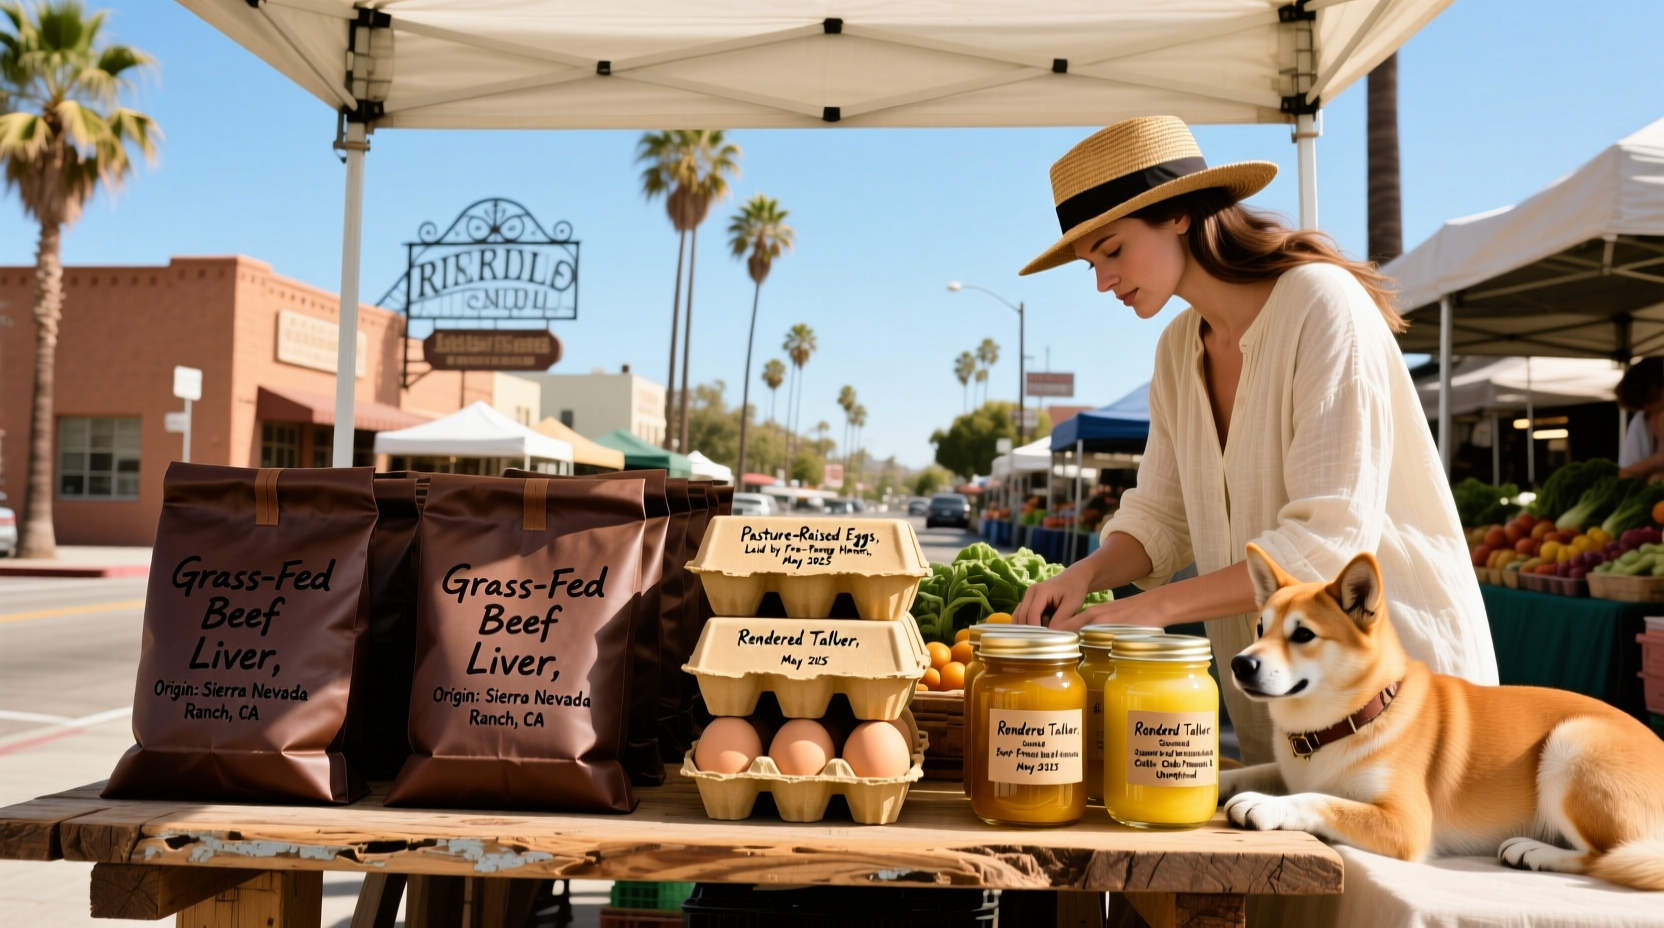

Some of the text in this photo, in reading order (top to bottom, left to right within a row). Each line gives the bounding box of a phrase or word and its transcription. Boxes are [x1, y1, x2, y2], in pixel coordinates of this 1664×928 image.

[846, 527, 879, 548] Eggs,
[770, 543, 780, 557] by
[171, 555, 336, 597] Grass-Fed
[442, 563, 608, 603] Grass-Fed
[201, 596, 286, 636] Beef
[478, 603, 563, 643] Beef
[737, 628, 804, 647] Rendered
[189, 636, 280, 677] Liver,
[466, 641, 559, 682] Liver,
[780, 654, 803, 670] May
[154, 680, 308, 701] Origin: Sierra Nevada
[433, 686, 591, 708] Origin: Sierra Nevada
[184, 703, 259, 723] Ranch, CA
[469, 709, 544, 729] Ranch, CA
